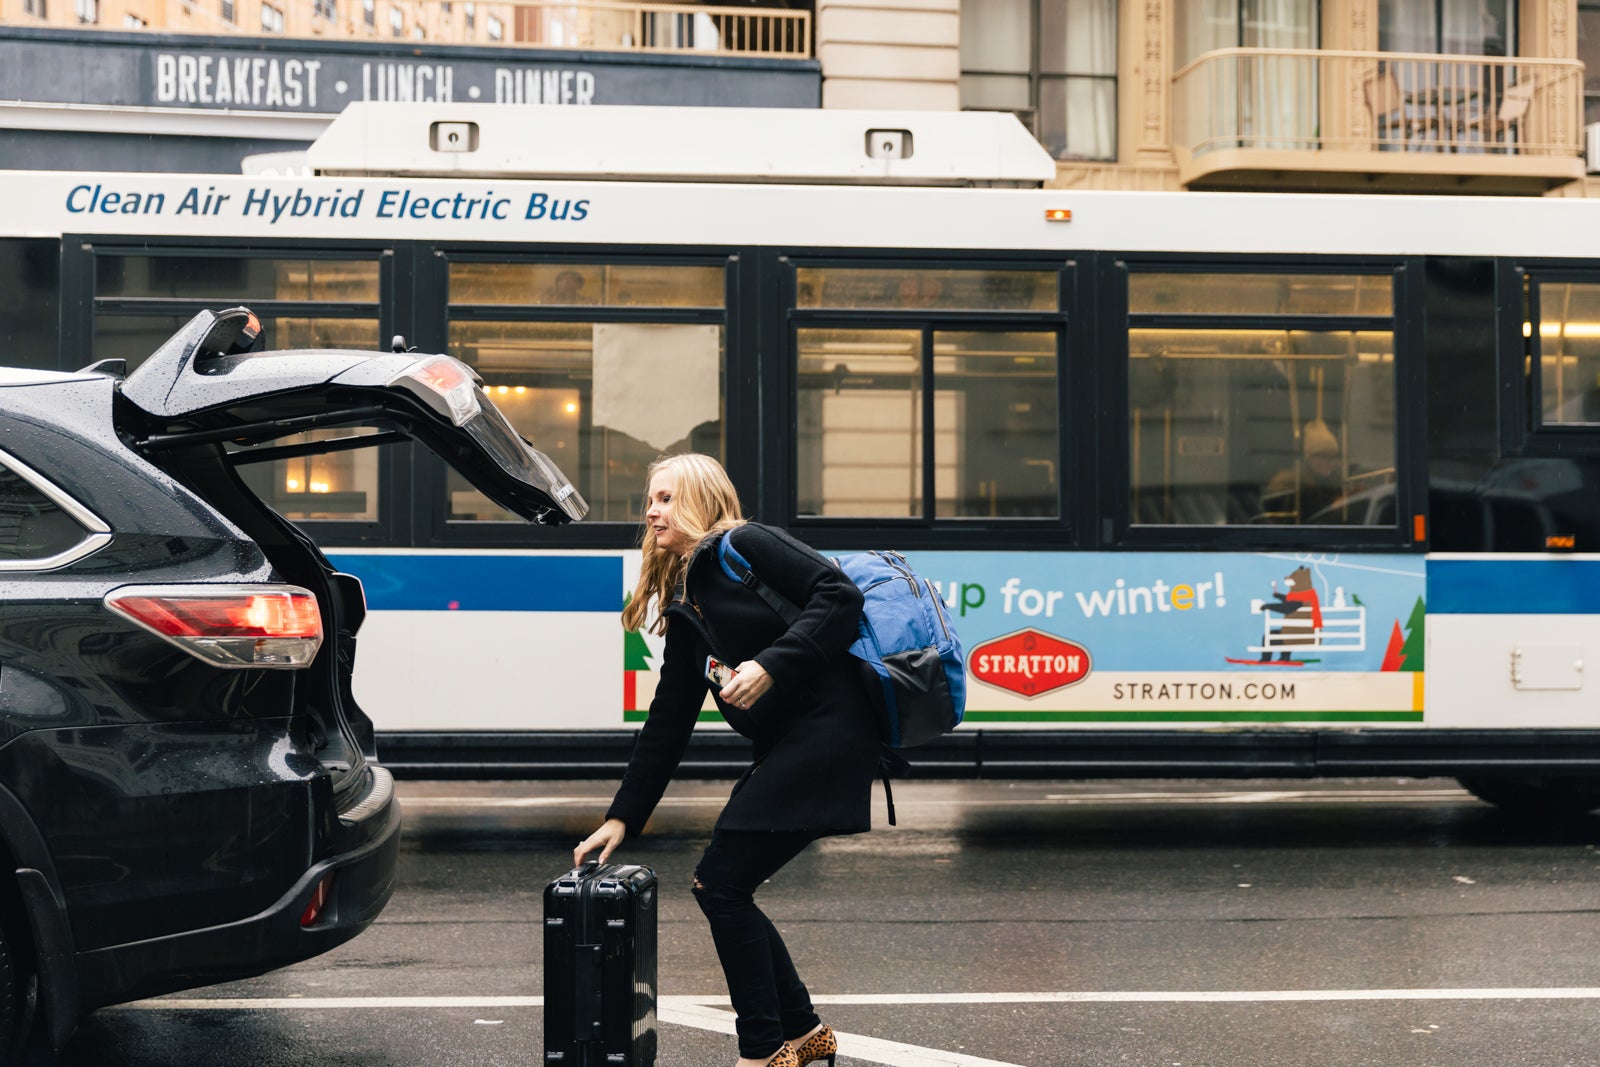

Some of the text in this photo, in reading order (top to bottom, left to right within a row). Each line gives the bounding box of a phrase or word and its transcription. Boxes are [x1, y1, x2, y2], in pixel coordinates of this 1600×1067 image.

[157, 54, 595, 108] BREAKFAST LUNCH DINNER
[65, 184, 590, 225] Clean Air Hybrid Electric Bus
[934, 571, 1227, 618] up for winter!
[978, 654, 1081, 680] STRATTON
[1113, 683, 1296, 700] STRATTON.COM
